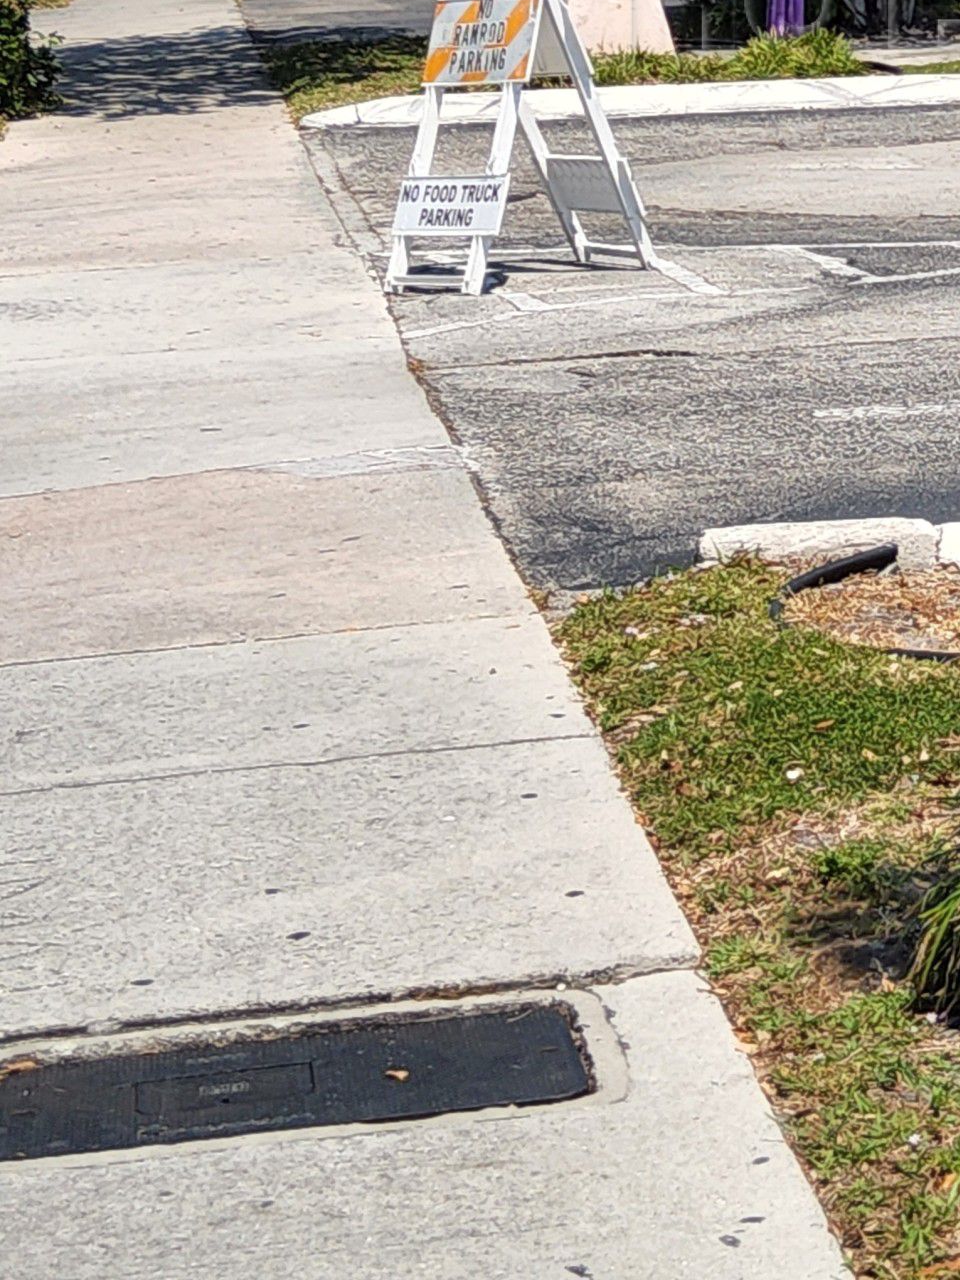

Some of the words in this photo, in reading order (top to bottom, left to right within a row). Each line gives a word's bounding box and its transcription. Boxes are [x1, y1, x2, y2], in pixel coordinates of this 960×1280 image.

[453, 21, 506, 46] RAMROD
[448, 48, 507, 74] PARKING
[401, 184, 420, 202] NO
[422, 184, 457, 202] FOOD
[460, 183, 502, 202] TRUCK
[418, 208, 474, 227] PARKING
